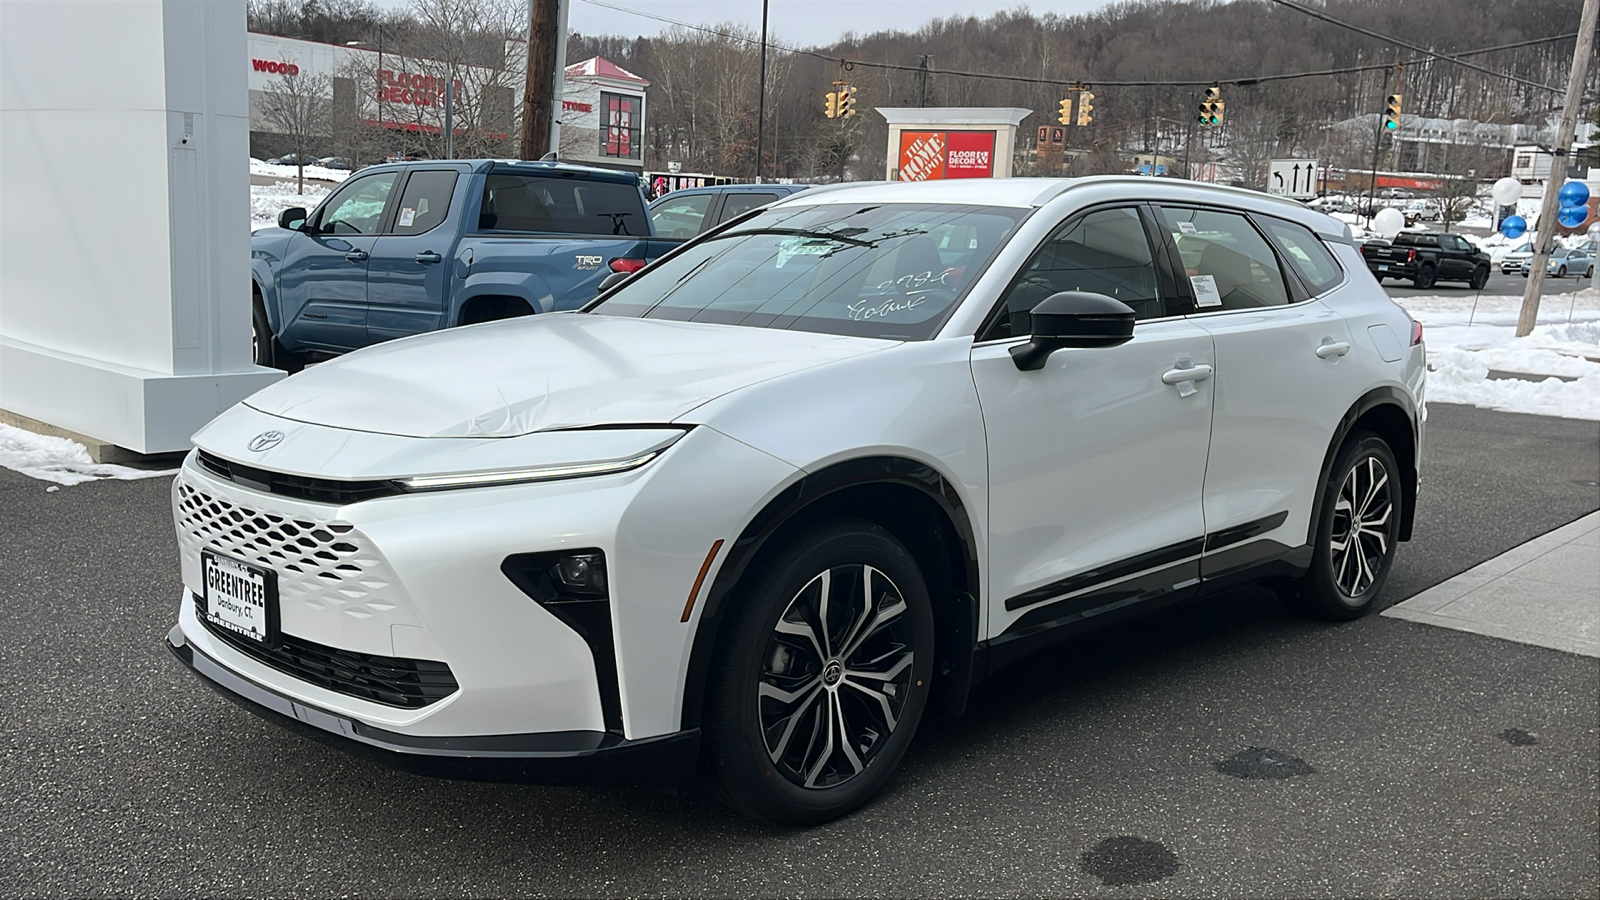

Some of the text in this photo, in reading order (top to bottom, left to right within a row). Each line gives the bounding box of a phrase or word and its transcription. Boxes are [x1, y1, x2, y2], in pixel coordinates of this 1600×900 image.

[252, 59, 299, 76] WOOD
[376, 69, 437, 92] FLOOR
[376, 86, 437, 107] DECOR
[899, 133, 945, 181] HOME
[905, 136, 926, 158] THE
[915, 151, 944, 181] DEPOT
[949, 157, 976, 165] DECOR
[575, 255, 603, 266] TRD
[208, 565, 264, 608] GREENTREE
[218, 595, 254, 619] Danbury, CT.
[206, 614, 264, 642] GREENTREE
